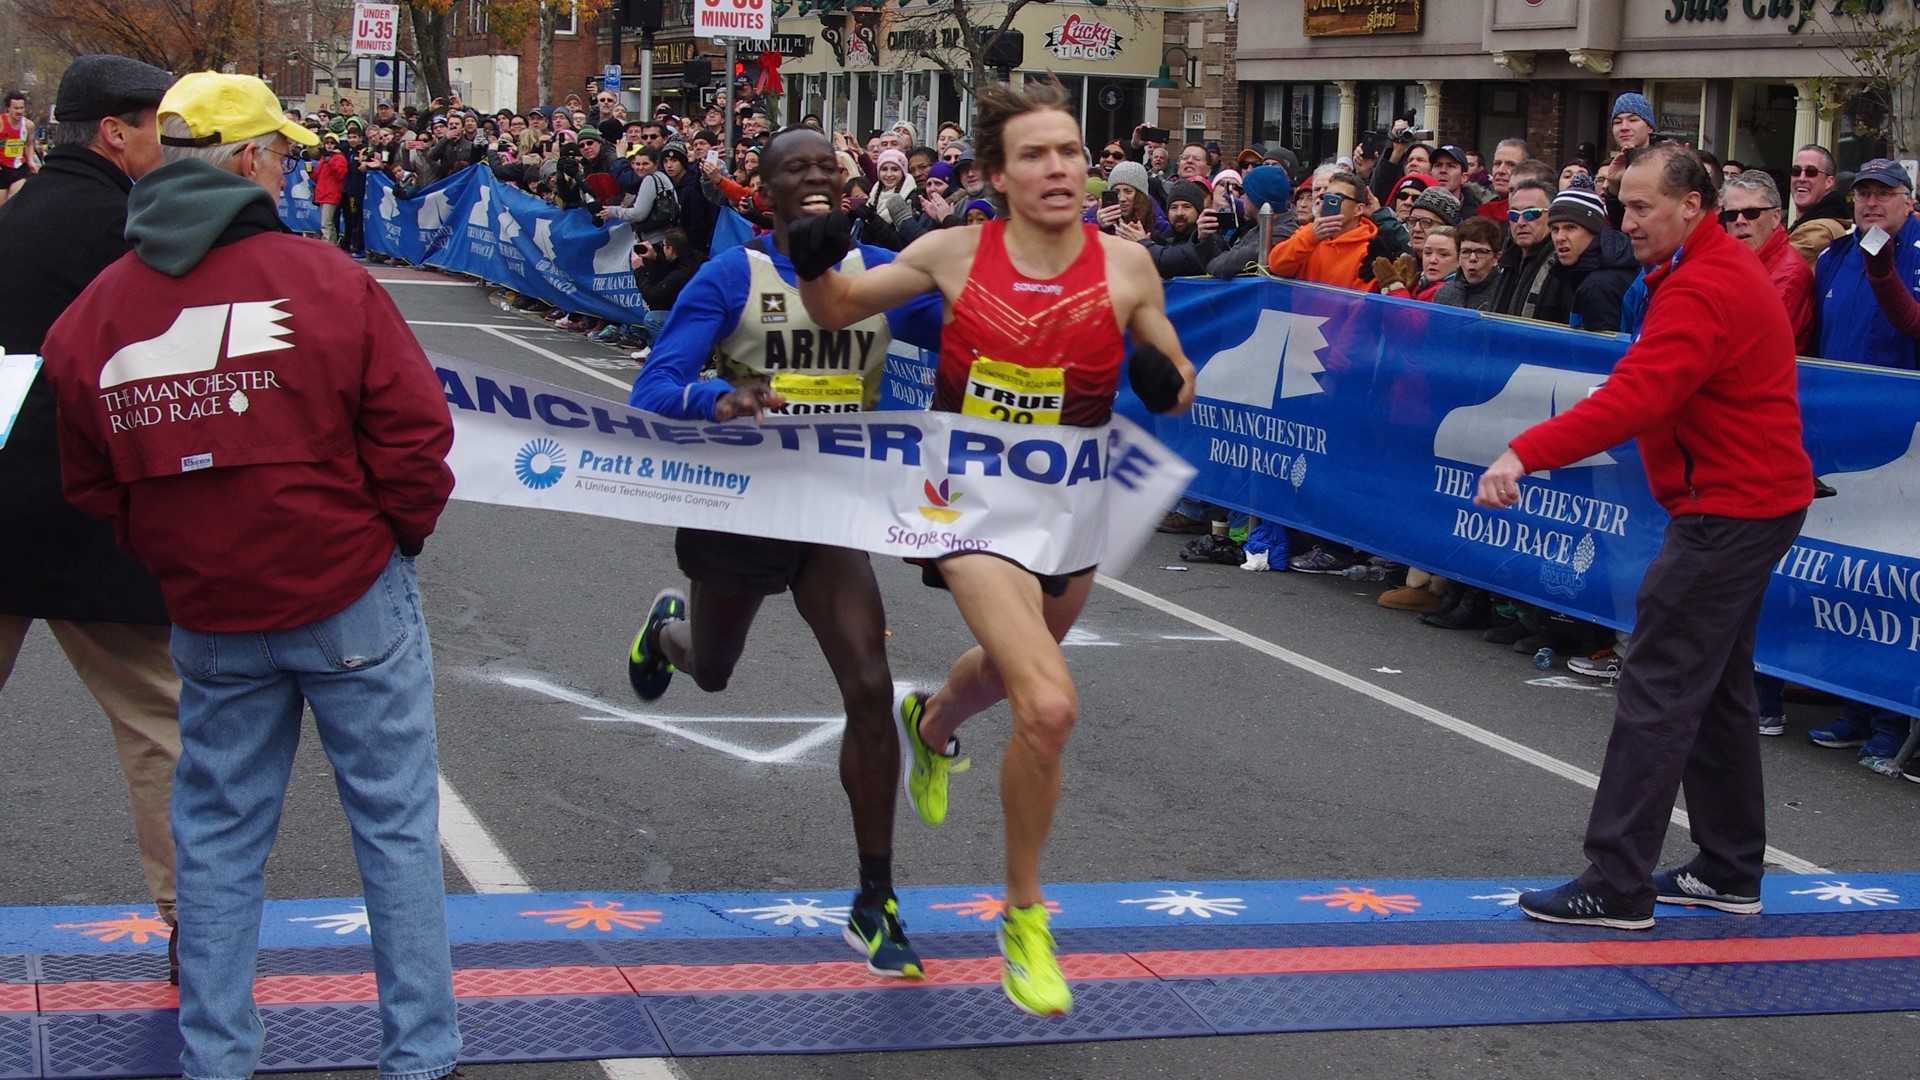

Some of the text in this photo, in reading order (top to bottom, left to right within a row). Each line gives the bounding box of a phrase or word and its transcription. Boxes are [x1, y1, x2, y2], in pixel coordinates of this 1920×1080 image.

[358, 20, 393, 40] U-35
[363, 8, 391, 20] UNDER
[701, 10, 764, 30] MINUTES
[1058, 13, 1112, 52] Lucky
[355, 40, 392, 51] MINUTES
[738, 37, 793, 54] PURNELL
[1060, 46, 1108, 58] TACO
[764, 328, 876, 371] ARMY
[100, 370, 282, 412] THE MANCHESTER
[889, 359, 937, 386] MANCHES
[890, 379, 916, 405] ROAD
[971, 381, 1061, 409] TRUE
[109, 395, 224, 434] ROAD RACE
[434, 366, 924, 466] ANCHESTER
[1190, 402, 1328, 455] THE MANCHESTER
[578, 449, 751, 496] Pratt & Whitney
[1208, 437, 1292, 481] ROAD RACE
[574, 479, 731, 511] A United Technologies Company
[1433, 464, 1475, 500] THE
[1452, 508, 1574, 565] ROAD RACE
[1774, 545, 1835, 585] THE
[1809, 595, 1902, 646] ROAD
